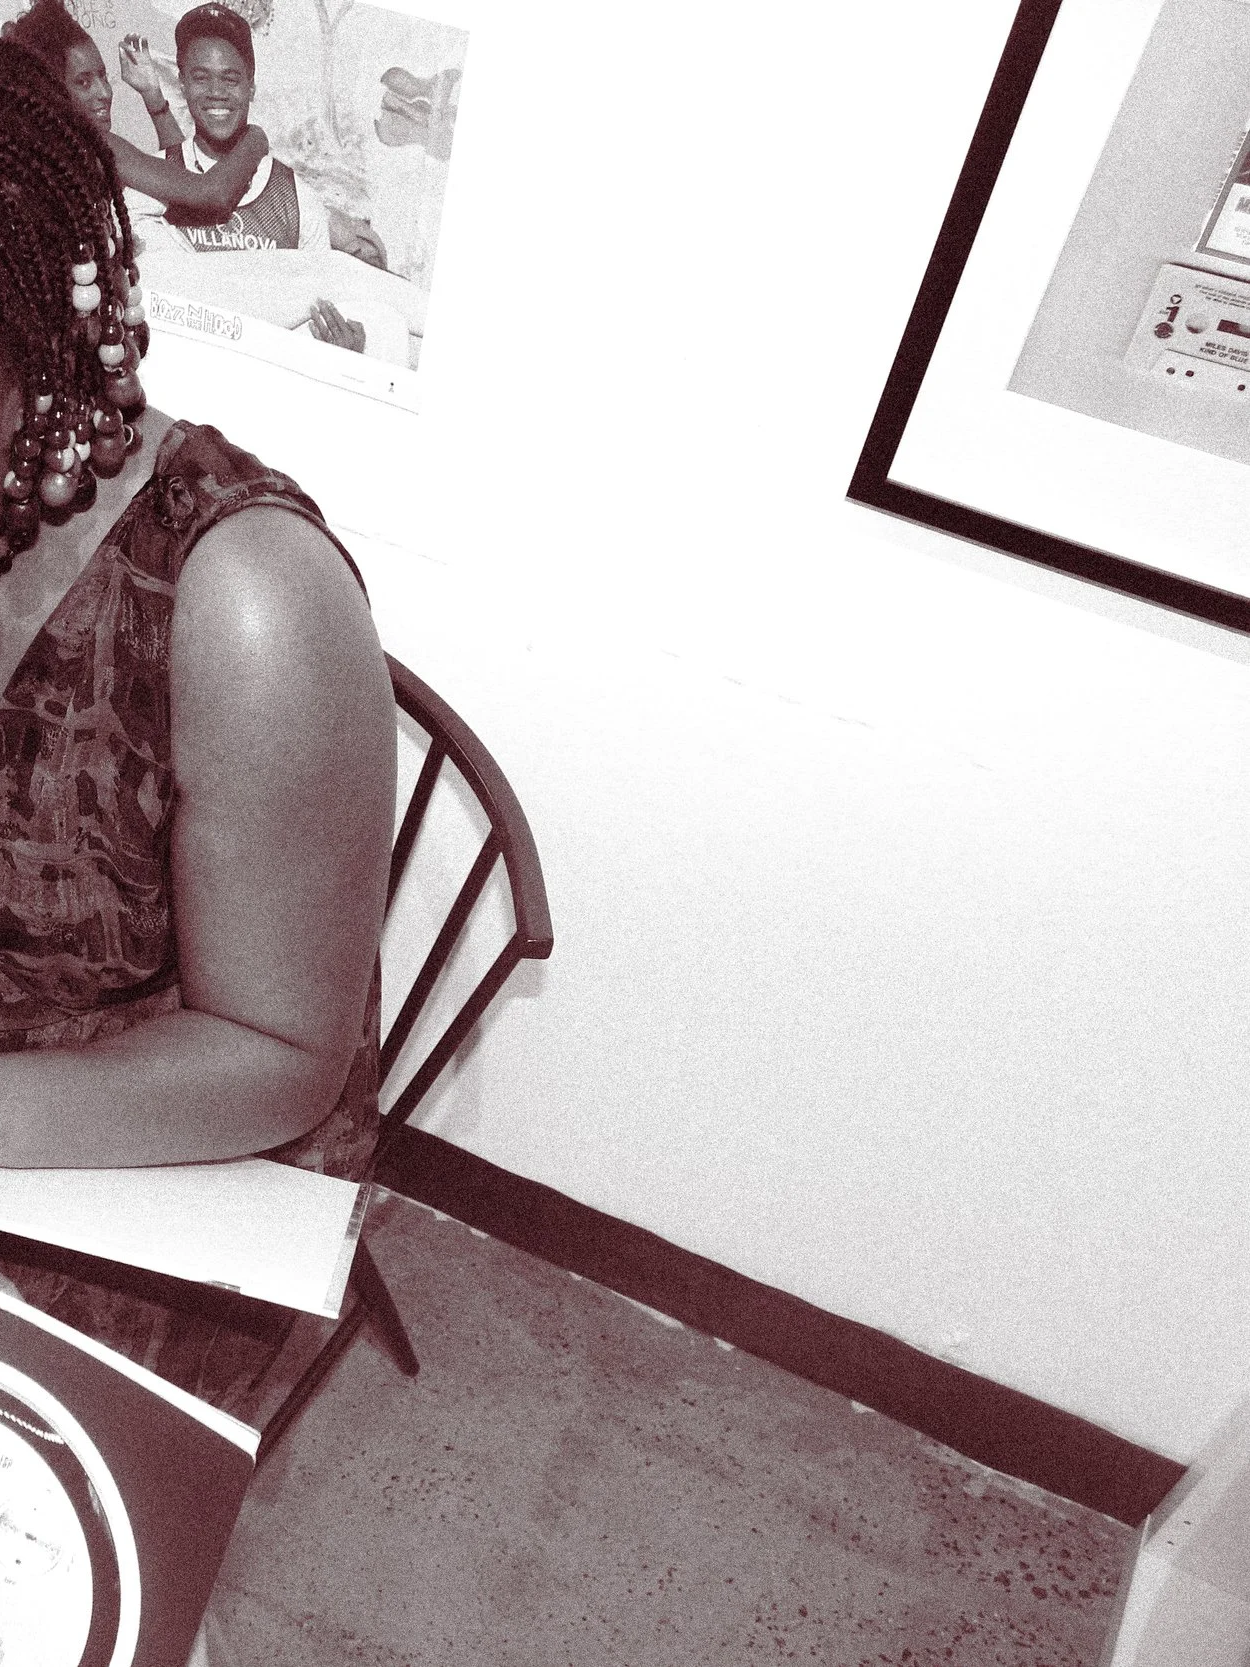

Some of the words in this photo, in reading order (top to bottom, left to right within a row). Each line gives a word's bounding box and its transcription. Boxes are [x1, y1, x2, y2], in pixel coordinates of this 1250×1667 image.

[187, 228, 277, 250] VILLANOVA
[150, 292, 185, 326] BOYZ
[1199, 348, 1217, 356] KIND
[1230, 356, 1248, 364] BLUE
[1205, 342, 1226, 351] MILES
[1228, 348, 1248, 356] DAVIS
